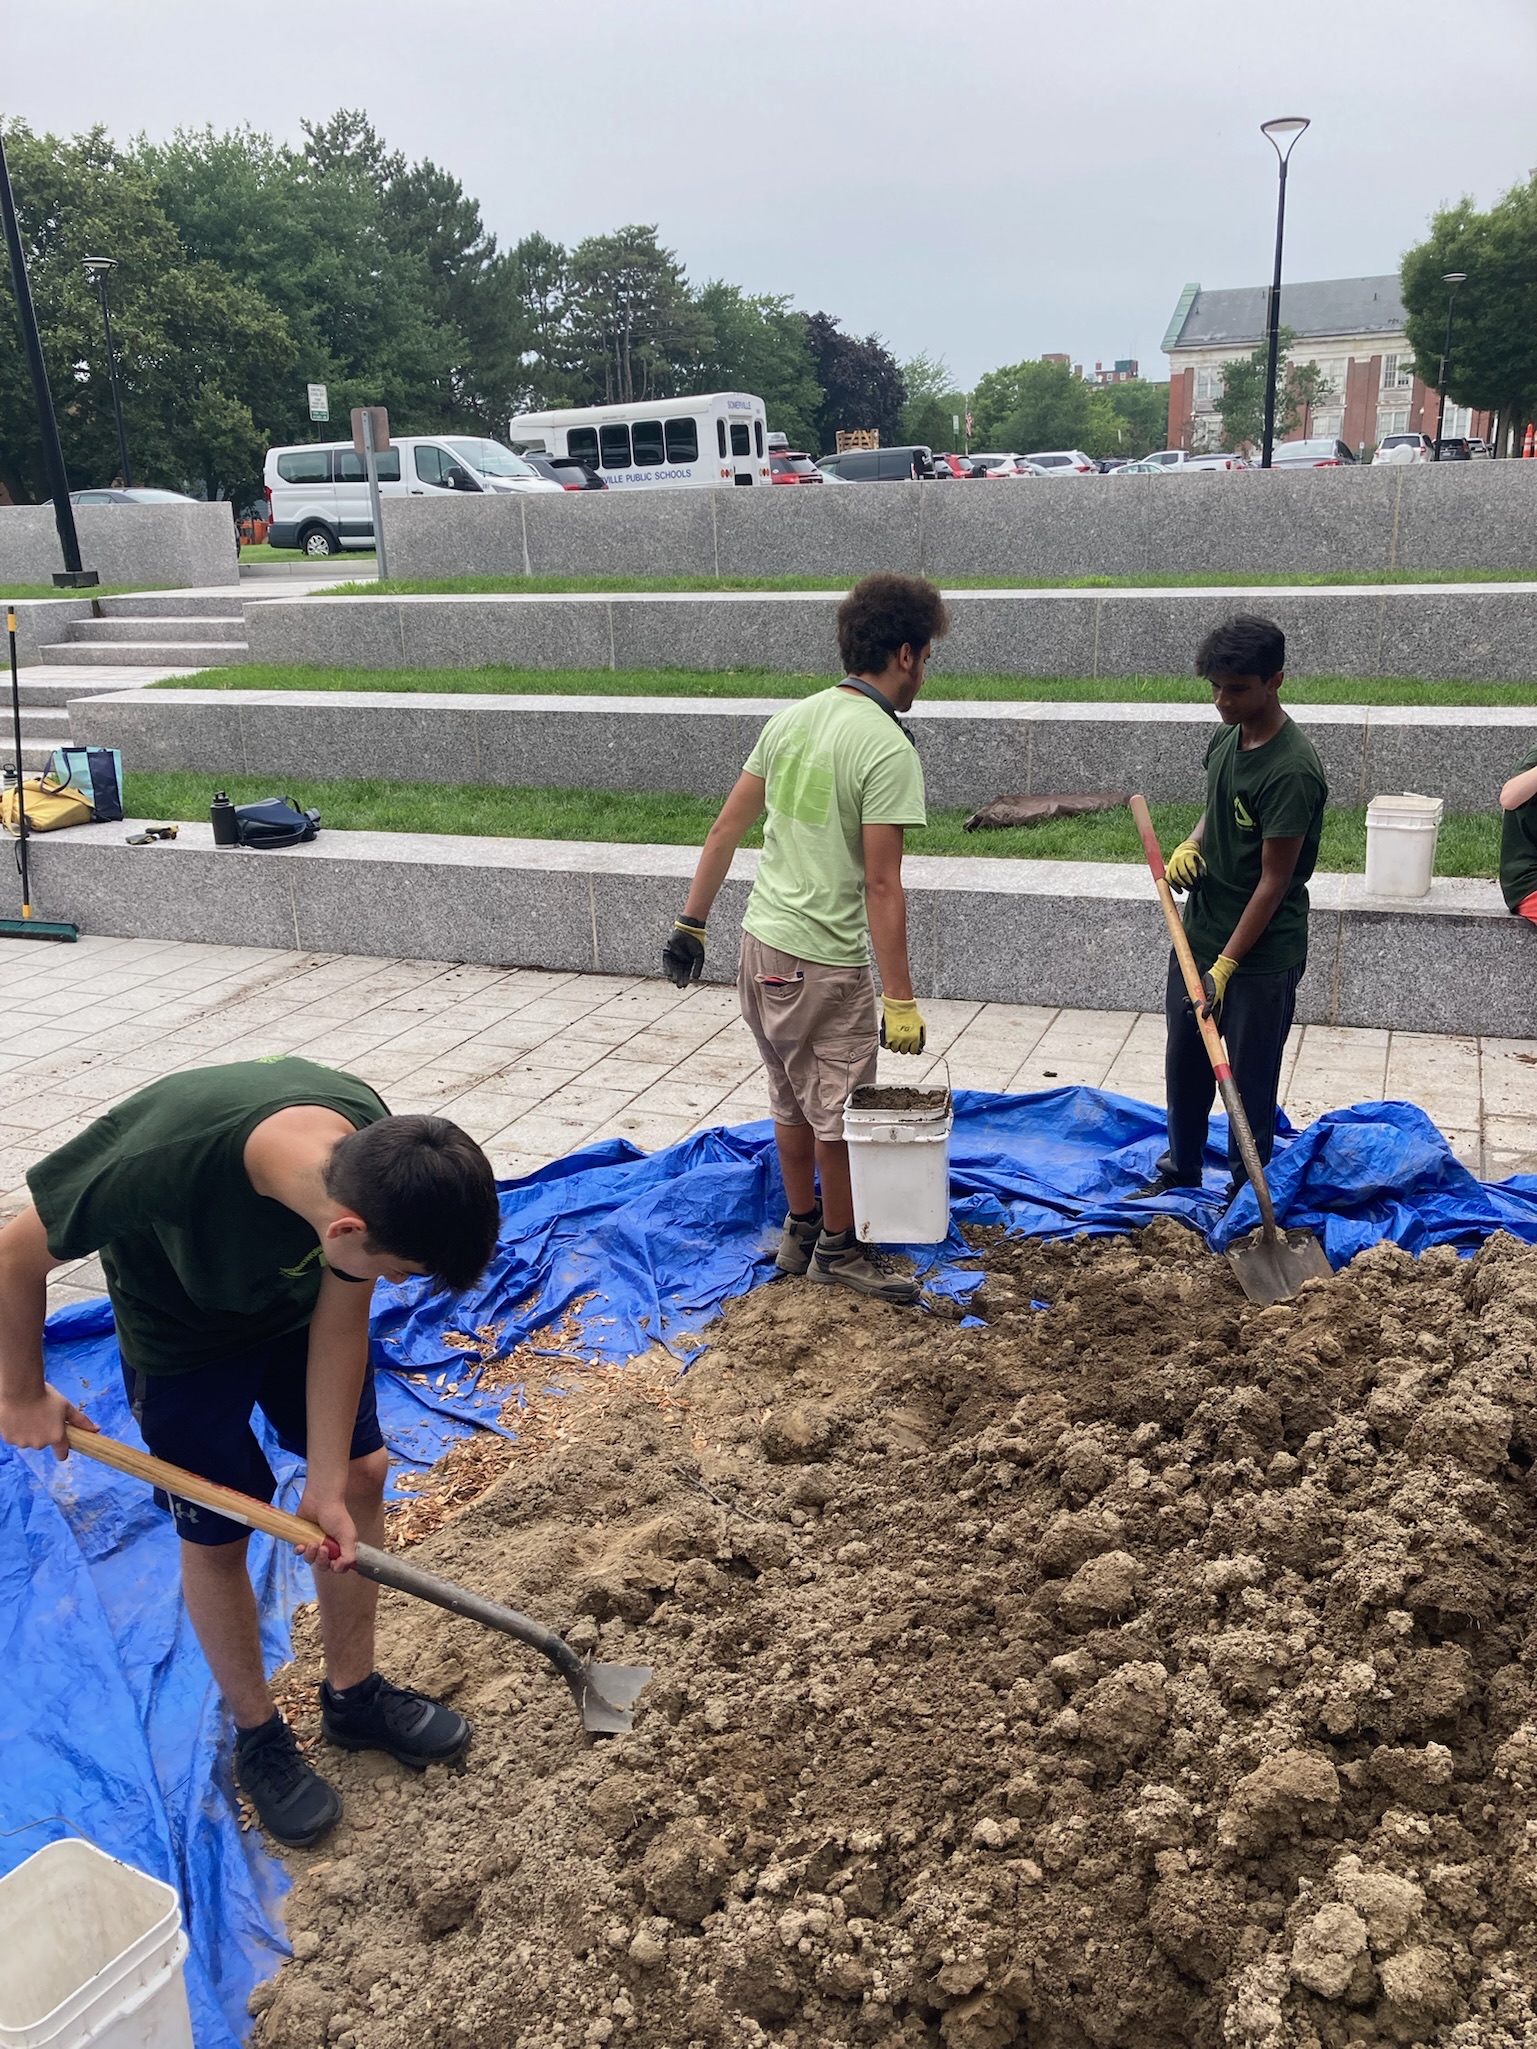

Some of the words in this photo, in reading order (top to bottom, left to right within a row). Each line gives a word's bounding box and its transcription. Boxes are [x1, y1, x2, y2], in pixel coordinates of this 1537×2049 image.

[727, 400, 752, 410] SOMERVILLE
[626, 471, 652, 482] PUBLIC
[654, 468, 692, 480] SCHOOLS
